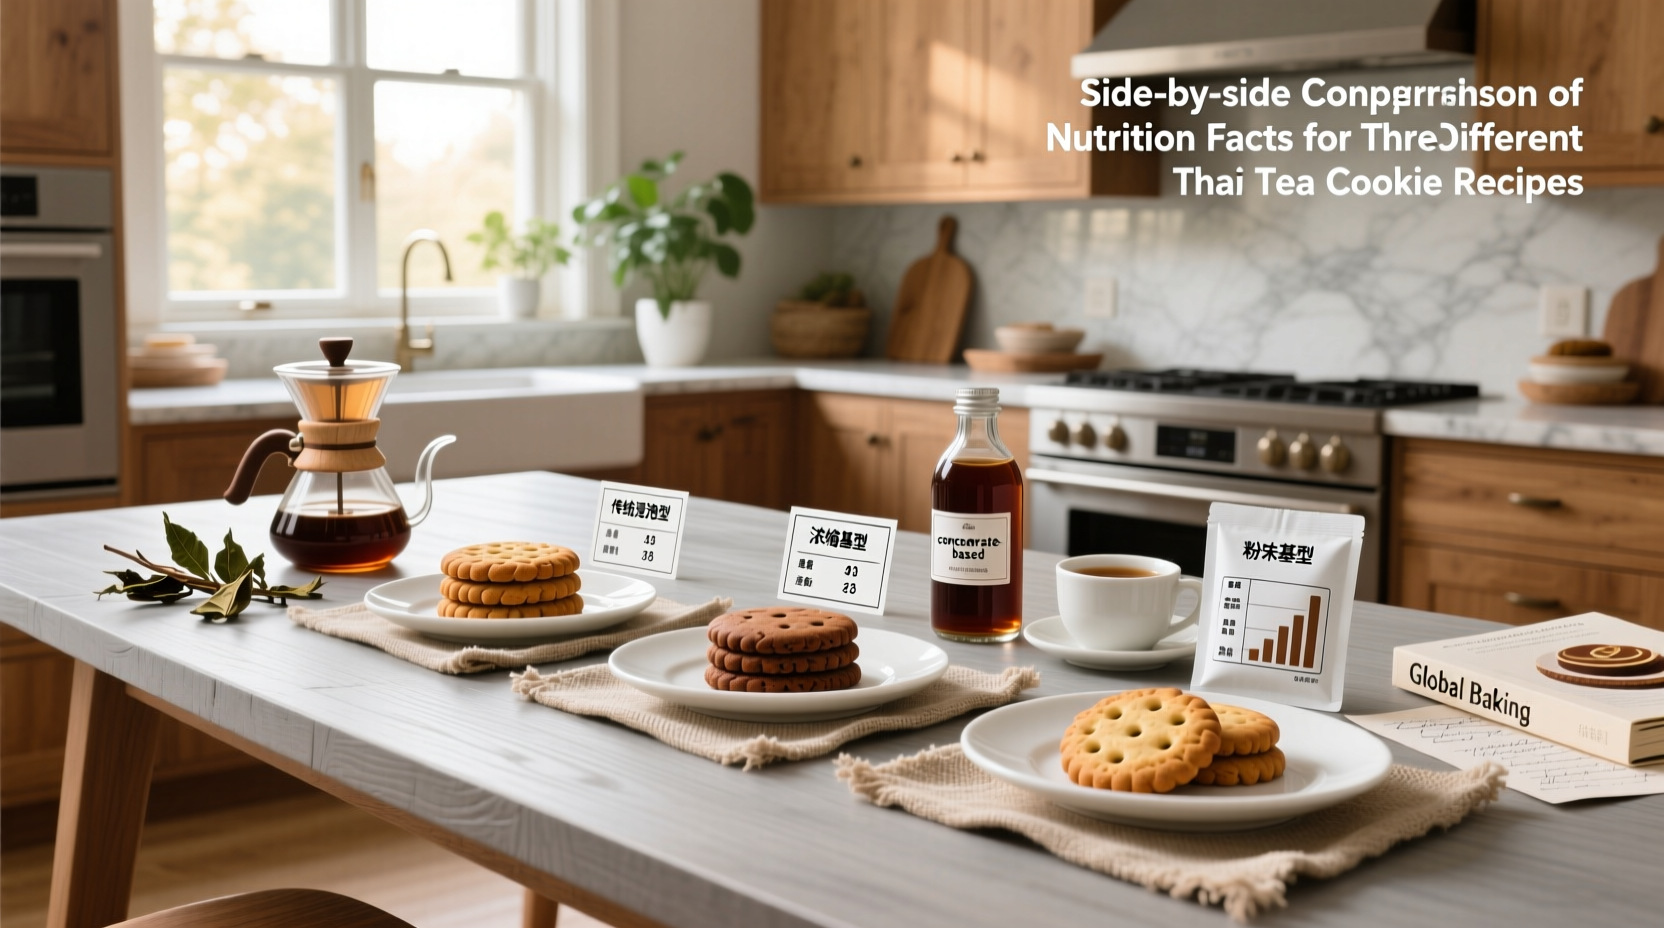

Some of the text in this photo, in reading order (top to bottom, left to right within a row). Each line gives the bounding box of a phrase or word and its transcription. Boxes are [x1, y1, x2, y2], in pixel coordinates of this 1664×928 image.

[952, 548, 985, 560] based
[1409, 662, 1531, 727] Global Baking
